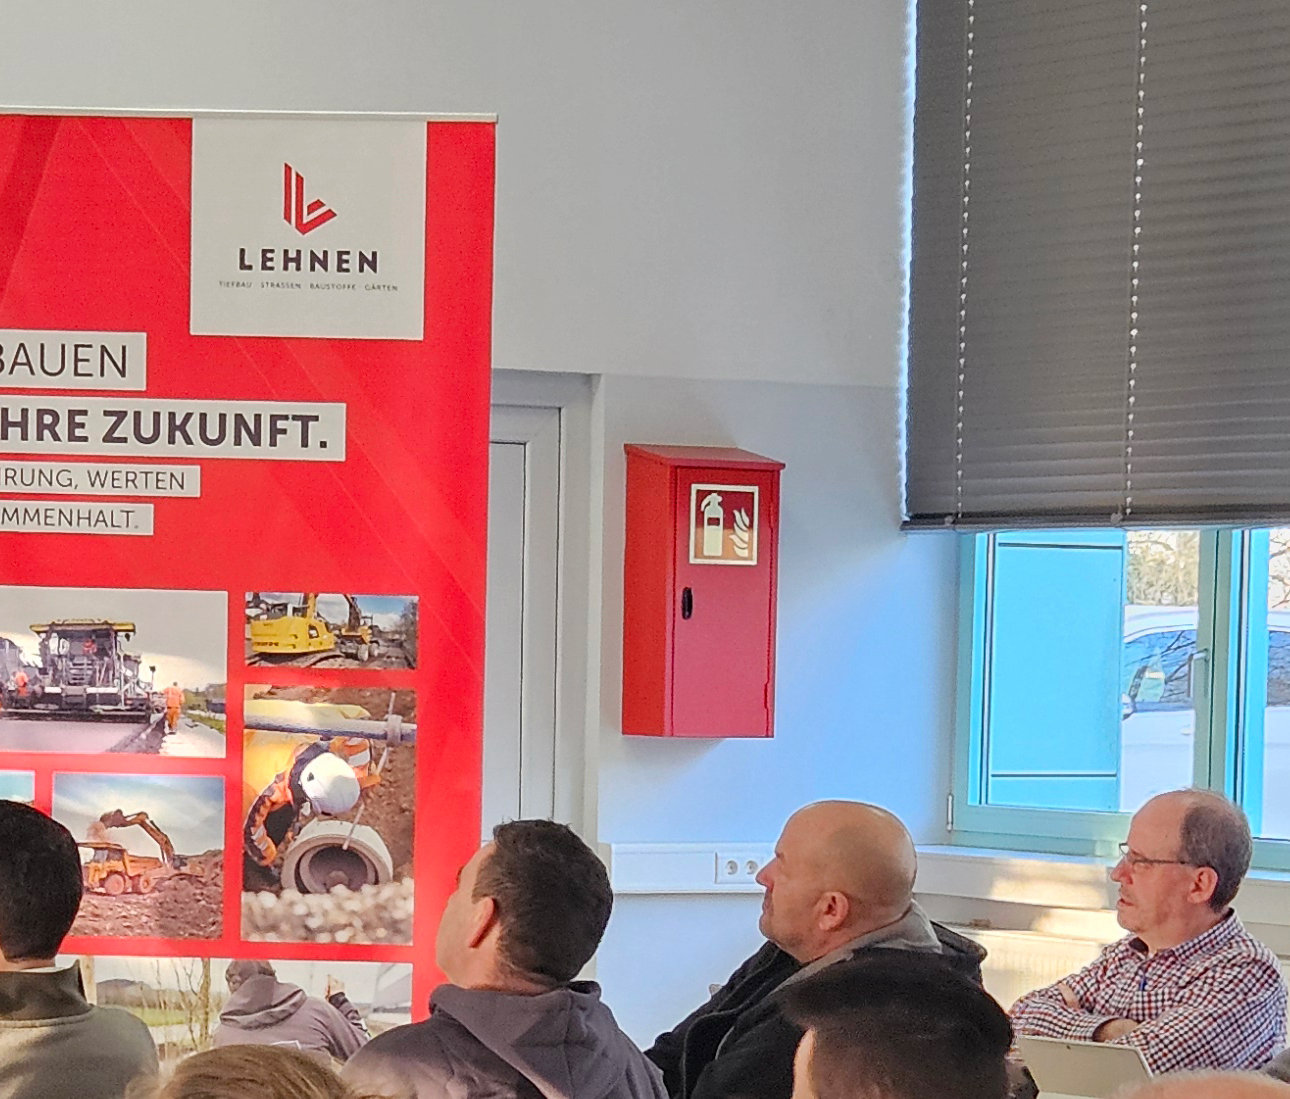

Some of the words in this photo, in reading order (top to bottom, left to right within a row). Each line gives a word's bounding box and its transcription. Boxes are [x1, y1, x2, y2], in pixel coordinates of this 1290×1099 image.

[238, 247, 379, 274] LEHNEN
[218, 280, 253, 289] TIEFBAU
[260, 281, 302, 290] STRASSEN
[309, 283, 357, 291] BAUSTOFFE
[101, 409, 329, 449] ZUKUNFT.
[87, 472, 186, 491] WERTEN
